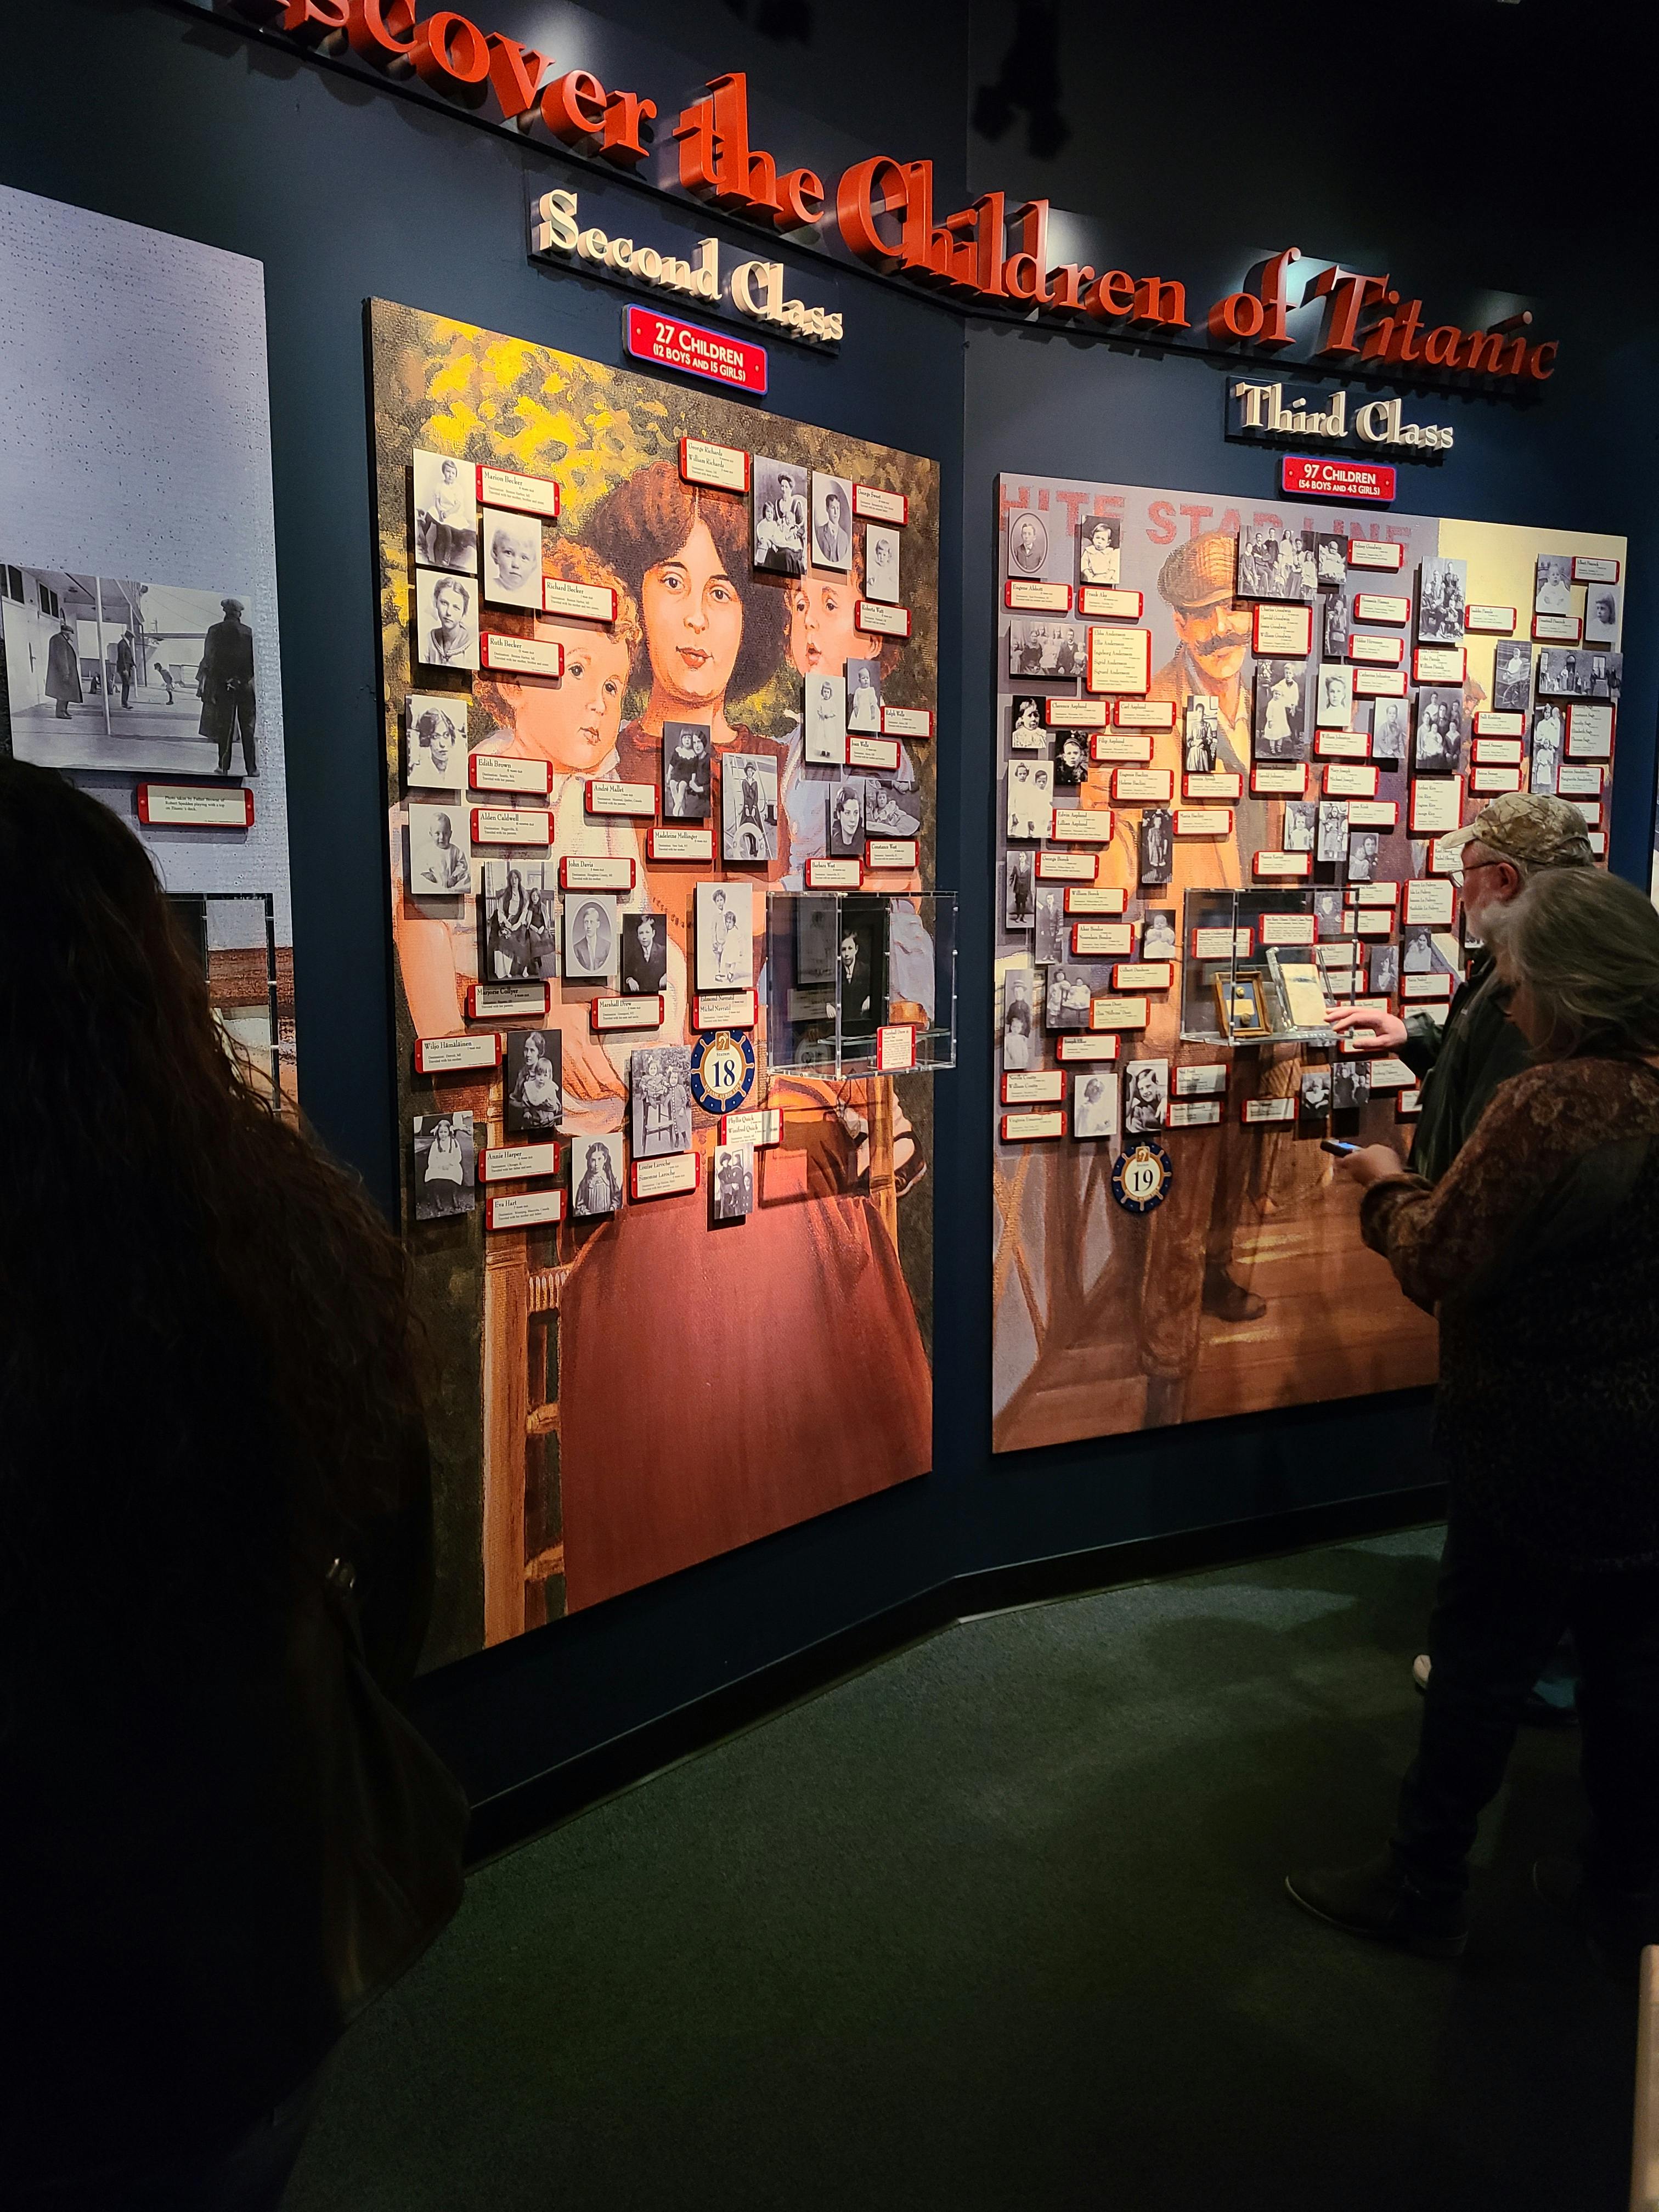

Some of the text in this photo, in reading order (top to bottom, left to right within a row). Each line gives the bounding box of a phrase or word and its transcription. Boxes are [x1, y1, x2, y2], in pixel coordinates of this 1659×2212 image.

[277, 0, 1559, 380] cover the Children of Titanic
[540, 189, 844, 341] Second Class
[656, 323, 743, 367] 27 CHILDREN
[653, 343, 746, 382] (12 BOYS AND 15 GIRLS)
[1235, 382, 1454, 450] Third Class
[689, 454, 705, 464] William
[484, 471, 522, 486] Marion Becker
[1304, 464, 1376, 484] 97 CHILDREN
[1299, 479, 1310, 489] (54
[1312, 481, 1331, 490] BOYS
[1358, 486, 1380, 495] GIRLS)
[1146, 501, 1283, 544] STA
[547, 582, 584, 594] Richard Becker
[490, 638, 522, 648] Ruth Becker
[478, 759, 493, 767] Edith
[425, 1041, 439, 1051] Wiljo
[712, 1060, 735, 1087] 18
[654, 1160, 670, 1169] Laroche
[1132, 1169, 1153, 1192] 19
